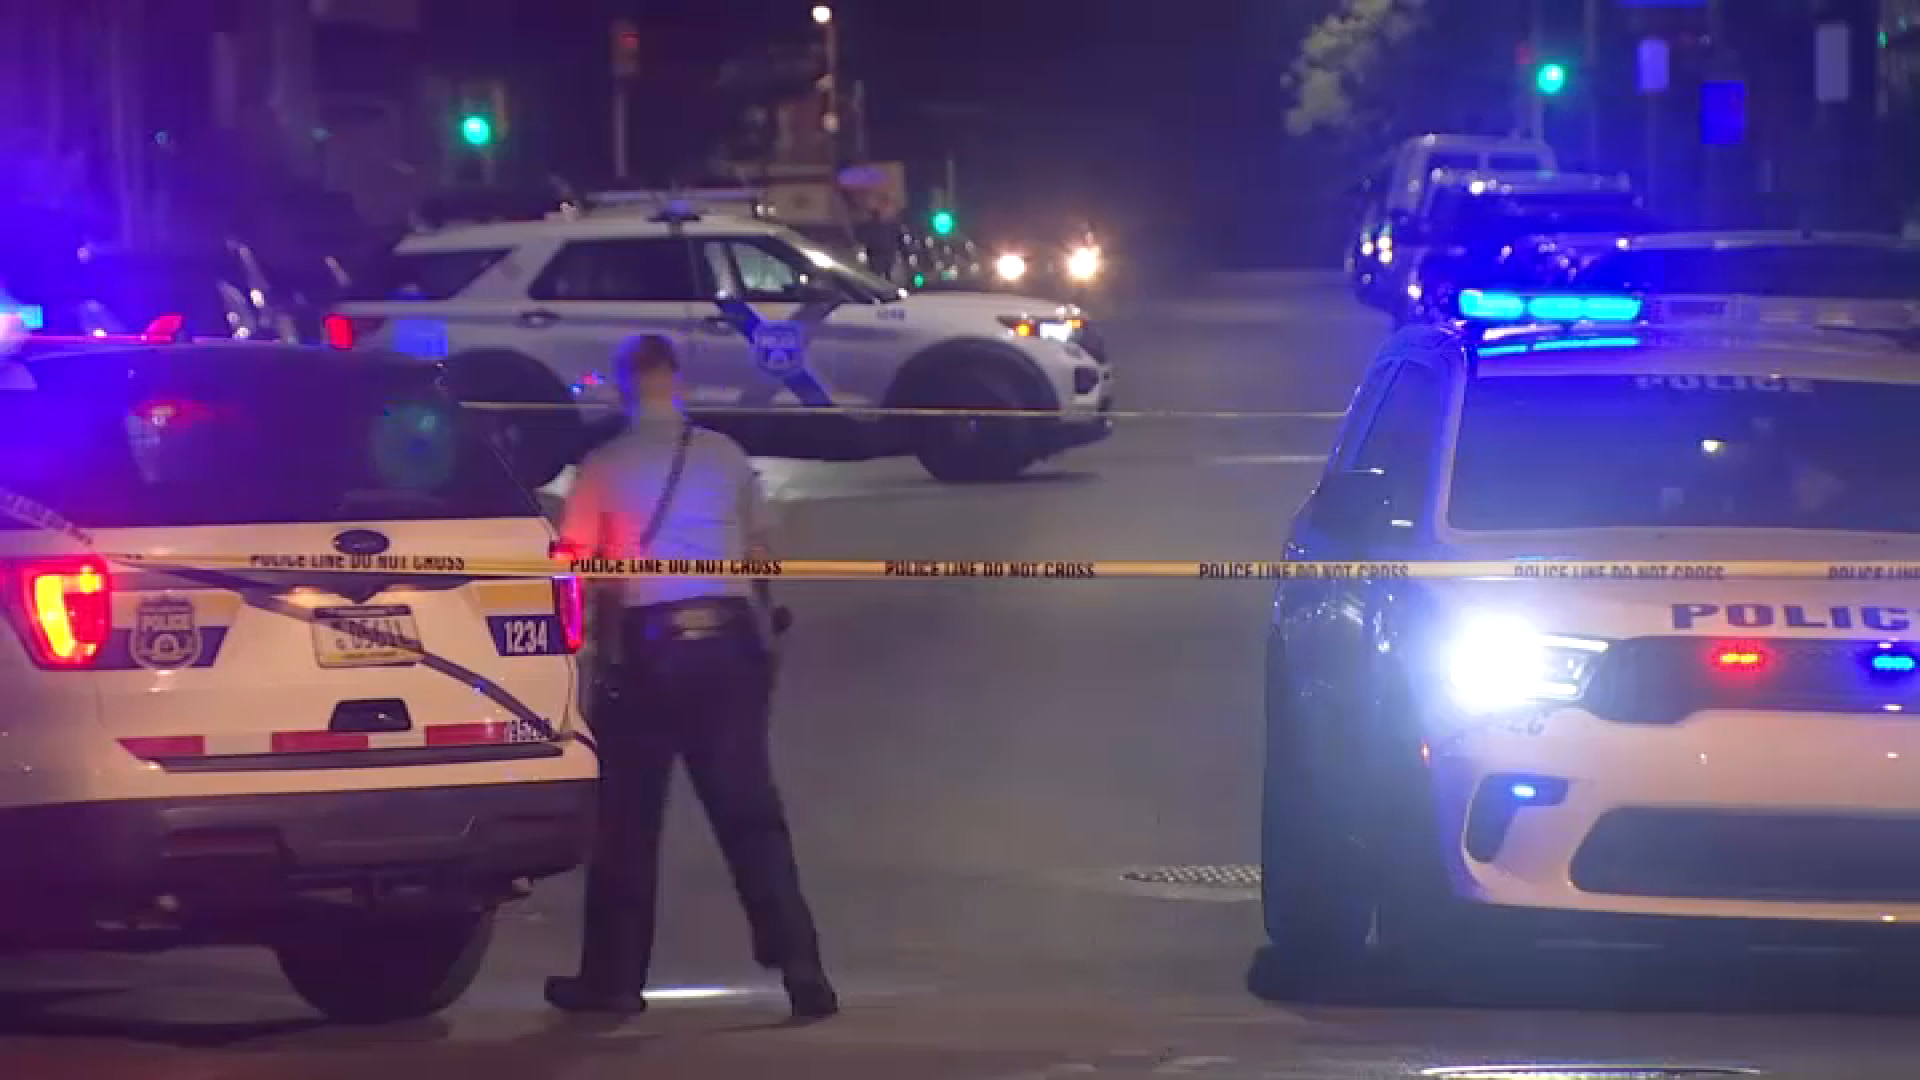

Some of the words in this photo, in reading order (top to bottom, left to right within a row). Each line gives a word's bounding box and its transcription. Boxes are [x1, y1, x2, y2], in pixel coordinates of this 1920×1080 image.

[250, 555, 306, 569] POLICE
[311, 555, 344, 569] LINE
[413, 556, 465, 571] CROSS
[569, 559, 625, 573] POLICE
[630, 559, 662, 573] LINE
[668, 559, 689, 573] DO
[695, 559, 724, 573] NOT
[730, 560, 783, 575] CROSS
[885, 560, 940, 576] POLICE
[944, 560, 977, 576] LINE
[983, 561, 1003, 577] DO
[1008, 562, 1038, 577] NOT
[1044, 562, 1095, 578] CROSS
[1199, 562, 1254, 579] POLICE
[1258, 562, 1292, 579] LINE
[1358, 562, 1409, 580] CROSS
[1514, 564, 1569, 579] POLICE
[1573, 564, 1606, 579] LINE
[1828, 565, 1883, 580] POLICE
[1671, 603, 1920, 631] POLIC
[504, 620, 548, 653] 1234
